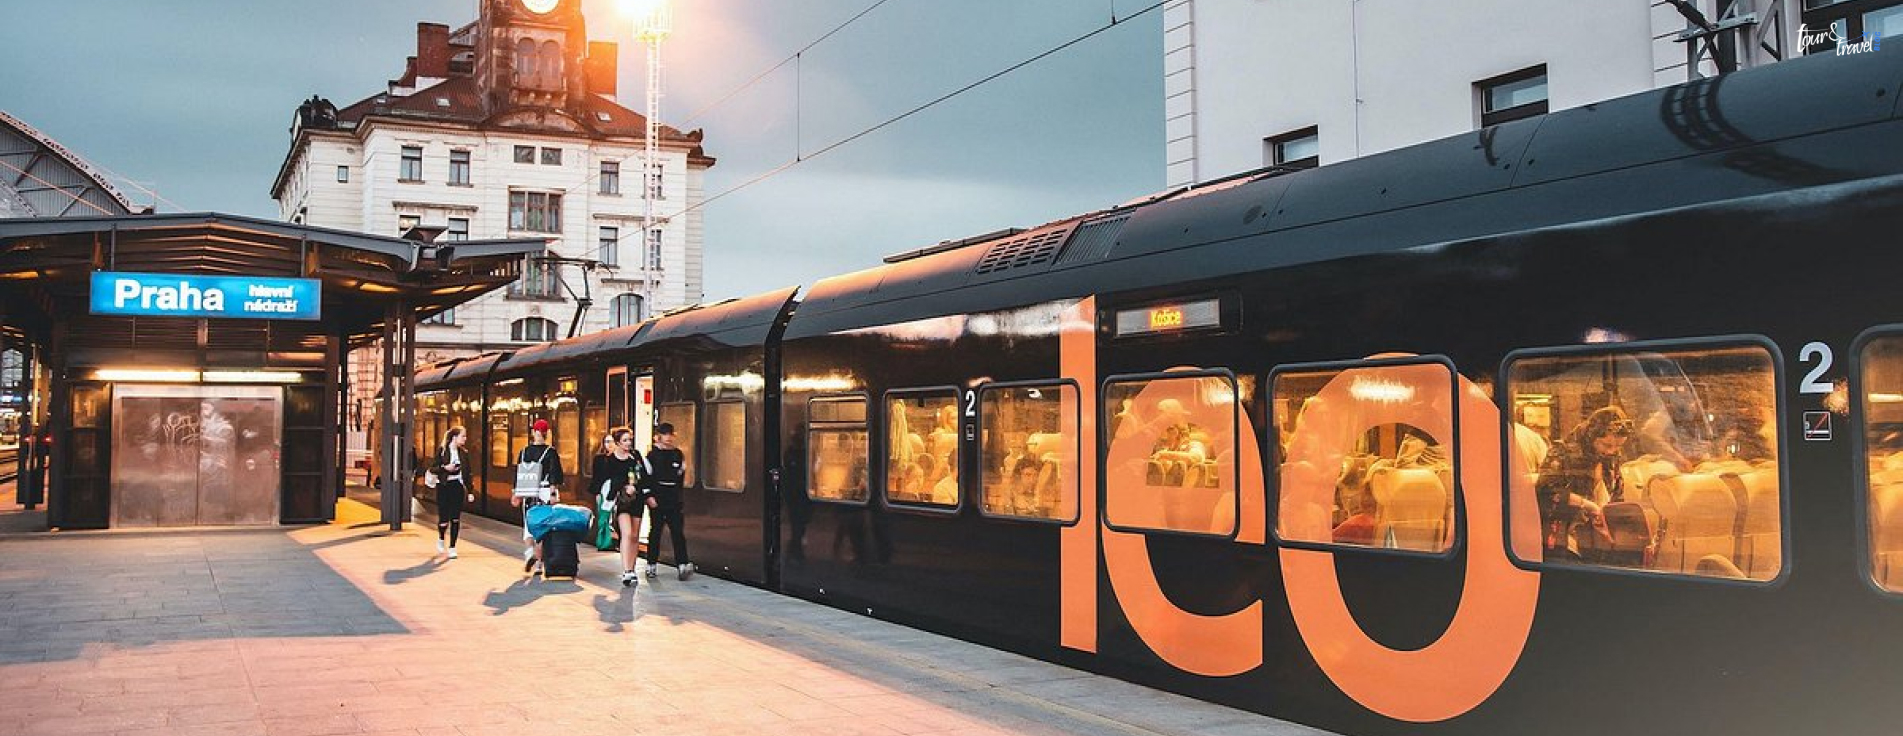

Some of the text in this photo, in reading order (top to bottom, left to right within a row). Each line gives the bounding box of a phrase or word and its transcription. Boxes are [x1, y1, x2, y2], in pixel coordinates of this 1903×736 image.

[114, 279, 224, 311] Praha
[248, 284, 294, 298] hlavní
[244, 299, 298, 313] nádraží
[1799, 341, 1833, 394] 2
[965, 390, 975, 417] 2
[1060, 294, 1542, 722] leo
